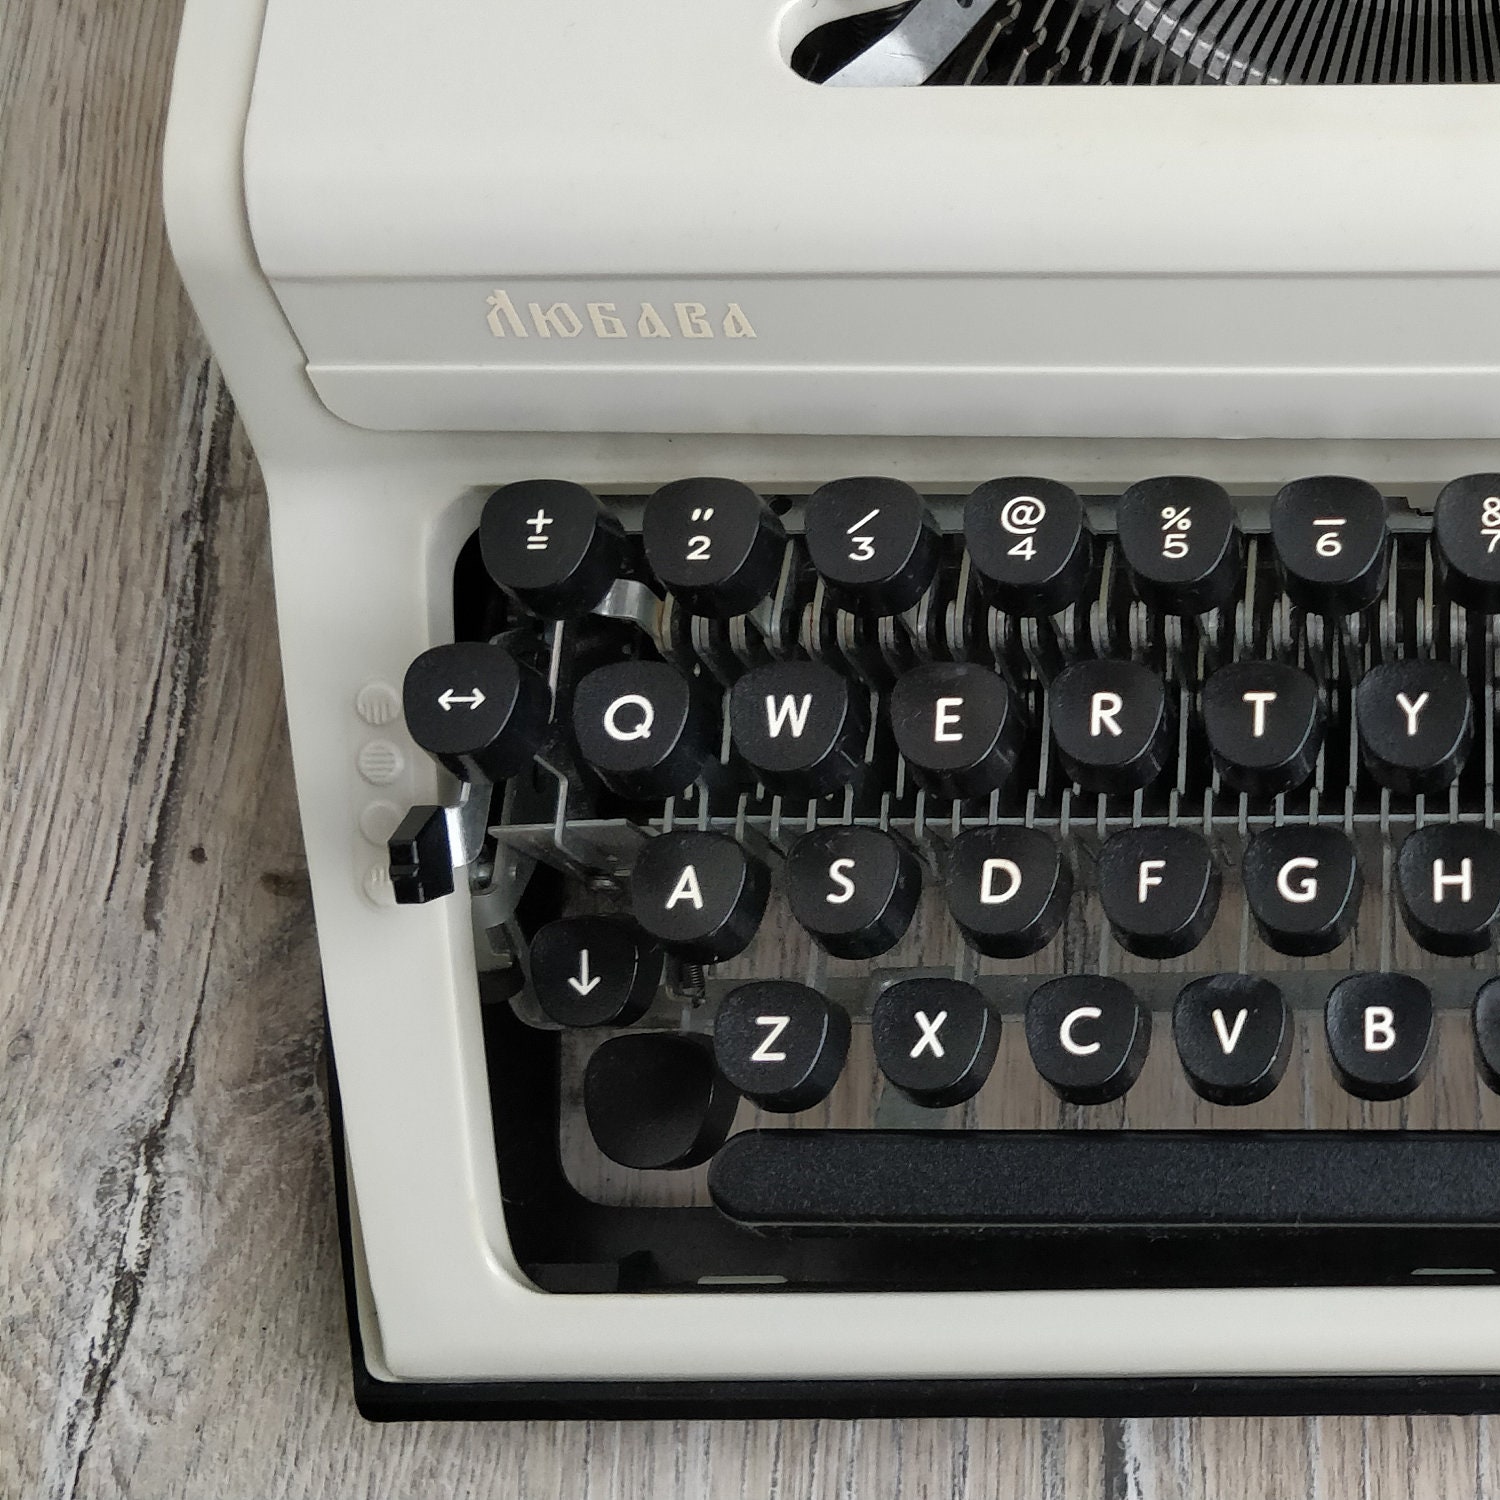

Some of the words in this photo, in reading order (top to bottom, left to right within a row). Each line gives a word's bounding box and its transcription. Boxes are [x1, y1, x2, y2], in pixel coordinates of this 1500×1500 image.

[1000, 495, 1046, 534] @
[686, 535, 711, 560] 2
[848, 536, 876, 561] 3
[1007, 534, 1037, 561] 4
[1162, 533, 1189, 560] 5
[1315, 532, 1342, 557] 6
[604, 694, 654, 741] Q
[766, 693, 813, 738] W
[934, 697, 964, 742] E
[1090, 692, 1123, 737] R
[1243, 692, 1277, 737] T
[1396, 692, 1430, 736] Y
[666, 864, 704, 910] A
[826, 858, 855, 904] S
[980, 858, 1022, 904] D
[1138, 860, 1166, 903] F
[1277, 857, 1319, 903] G
[1433, 857, 1472, 903] H
[750, 1016, 790, 1062] Z
[910, 1010, 948, 1058] X
[1059, 1007, 1102, 1055] C
[1212, 1008, 1248, 1054] V
[1364, 1006, 1396, 1052] B
